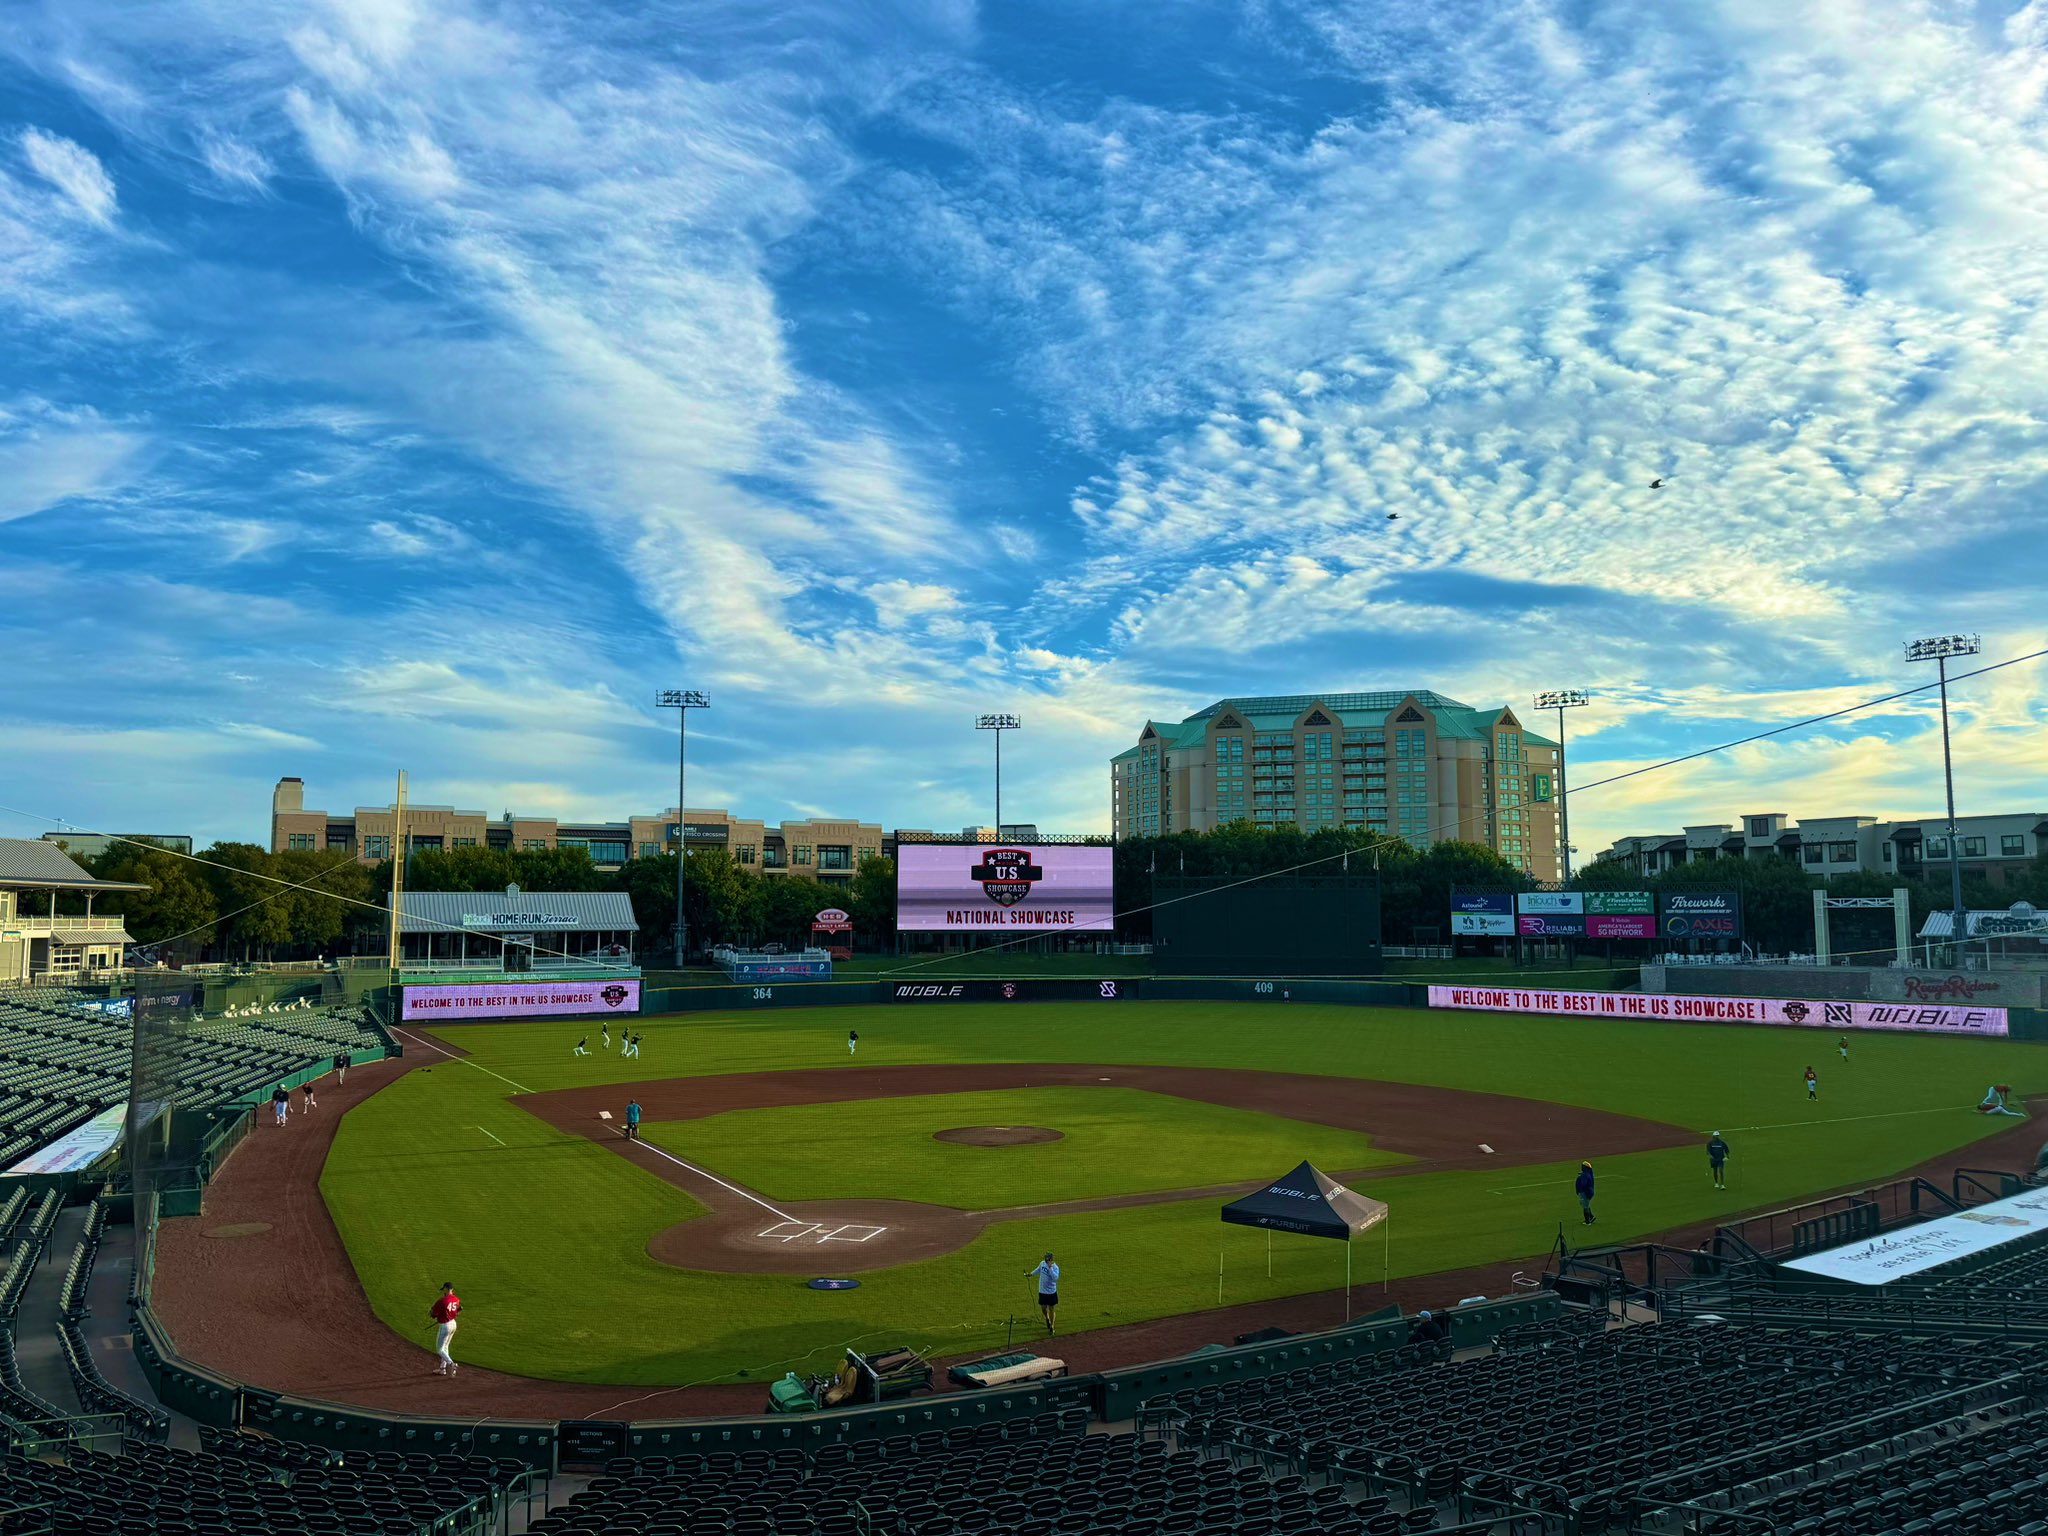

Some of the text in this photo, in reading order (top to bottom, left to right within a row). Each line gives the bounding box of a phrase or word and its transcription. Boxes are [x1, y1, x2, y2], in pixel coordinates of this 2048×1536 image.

[996, 866, 1020, 880] U.S.
[987, 884, 1027, 893] SHOWCASE
[1528, 895, 1558, 906] InTouch
[1672, 896, 1726, 909] Fireworks
[492, 914, 519, 924] HOME
[521, 914, 541, 924] RUN
[542, 914, 578, 924] Terrace
[947, 910, 1074, 924] NATIONAL SHOWCASE
[1692, 919, 1734, 930] AXIS
[753, 987, 772, 999] 364
[896, 986, 963, 996] NOBLE
[1255, 982, 1273, 993] 409
[412, 994, 593, 1009] WELCOME TO THE BEST IN THE US SHOWCASE
[1452, 990, 1766, 1019] WELCOME TO THE BEST IN THE US SHOWCASE !
[1868, 1007, 1986, 1027] NOBLE
[1268, 1186, 1320, 1201] NOBLE
[1326, 1185, 1346, 1201] NOBLE
[1270, 1219, 1310, 1231] PURSUIT
[447, 1302, 456, 1311] 45
